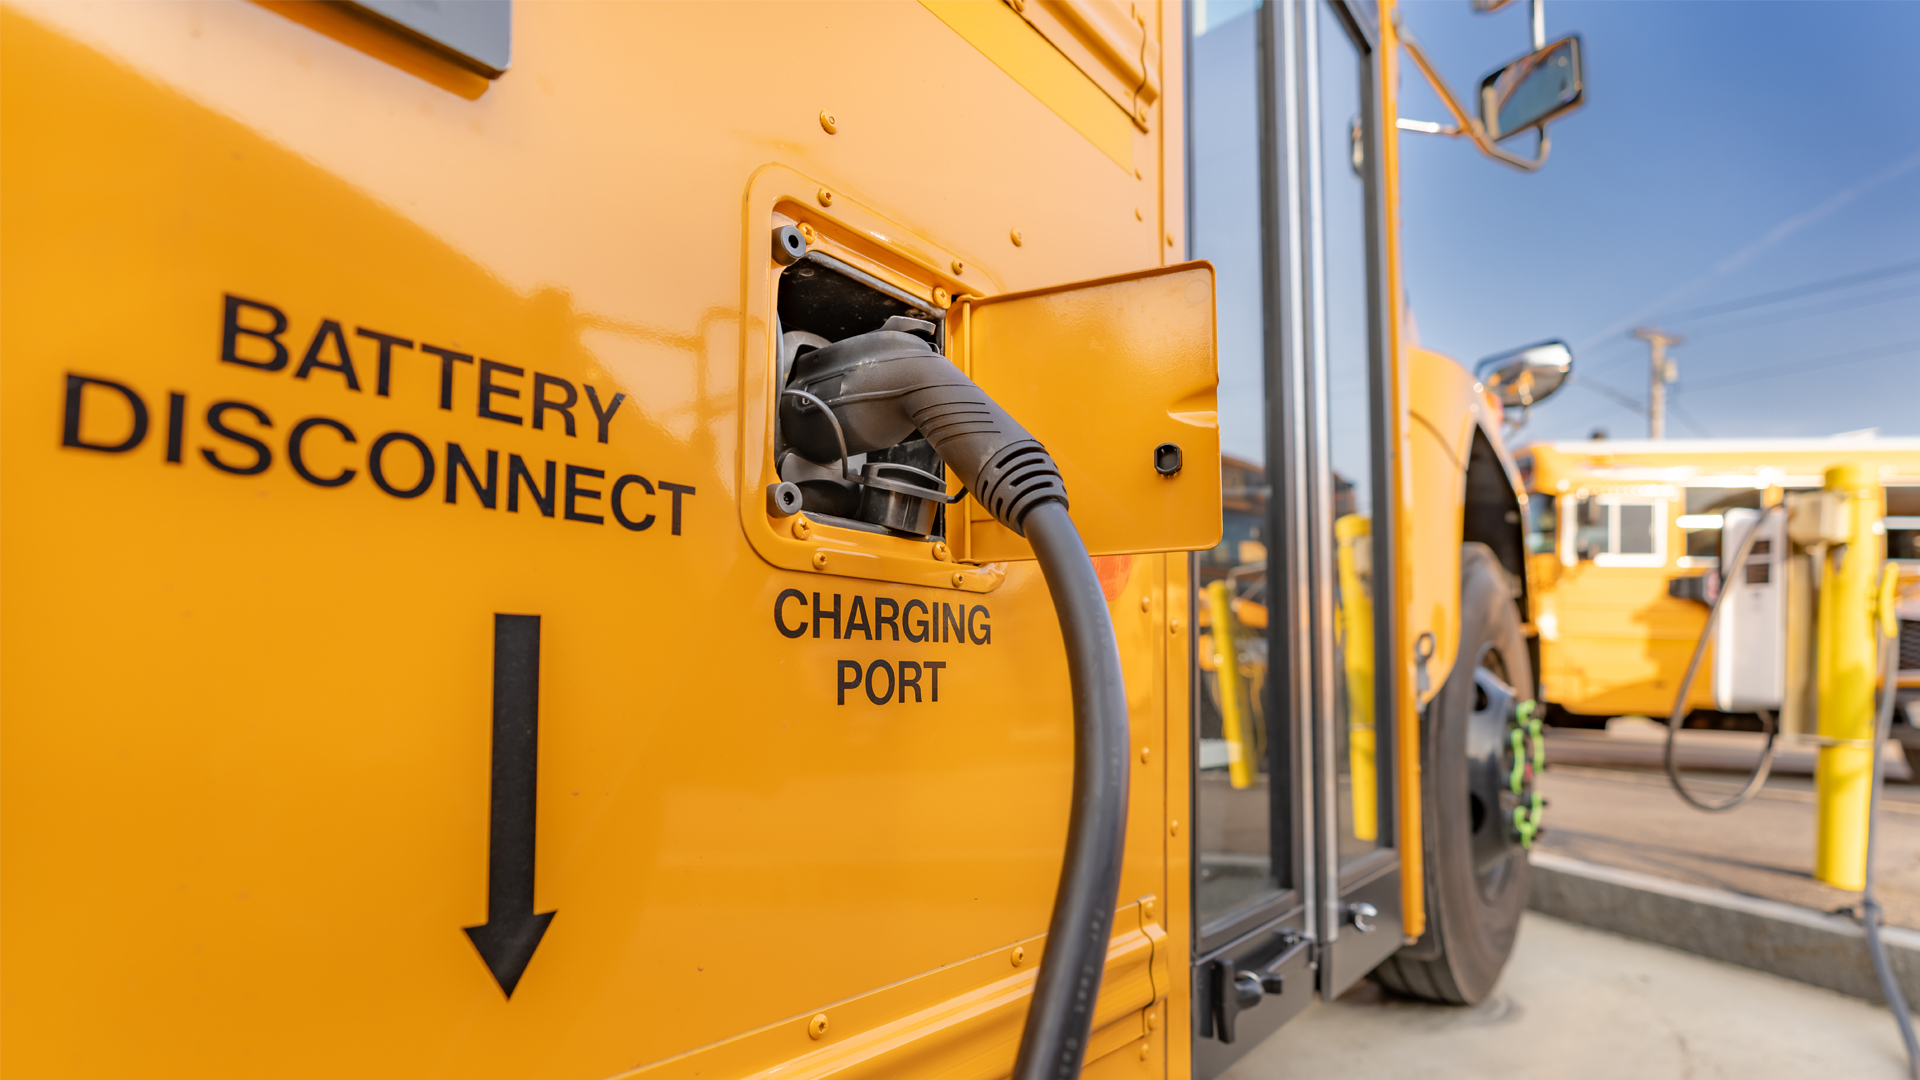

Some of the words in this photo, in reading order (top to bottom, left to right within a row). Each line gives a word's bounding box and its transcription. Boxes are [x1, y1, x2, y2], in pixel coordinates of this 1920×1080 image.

[219, 292, 626, 445] BATTERY
[59, 371, 697, 537] DISCONNECT
[773, 588, 992, 646] CHARGING
[836, 659, 947, 706] PORT
